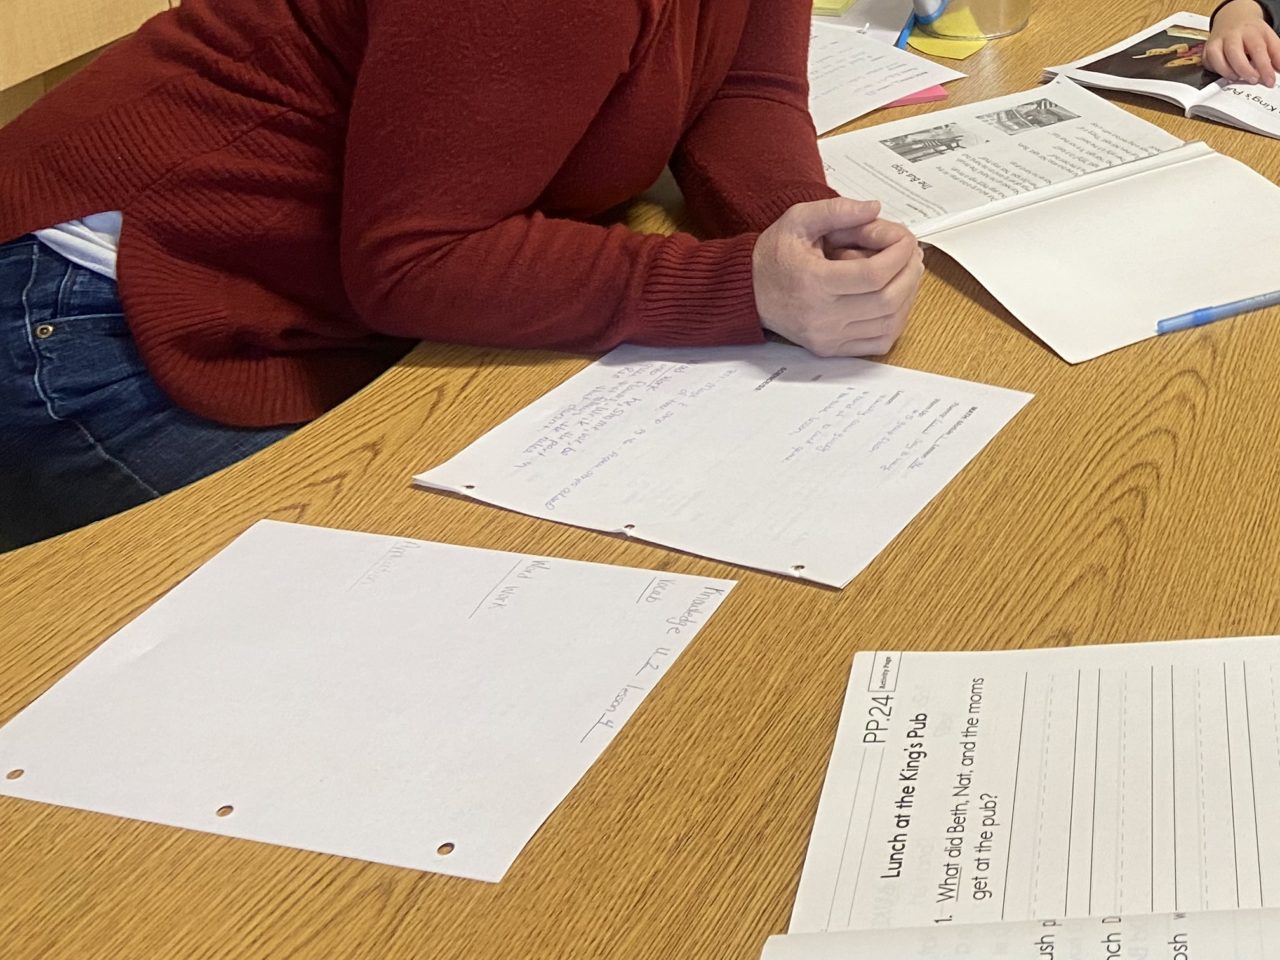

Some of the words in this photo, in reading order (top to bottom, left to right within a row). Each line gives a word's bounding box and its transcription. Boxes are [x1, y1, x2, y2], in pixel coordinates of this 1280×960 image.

[968, 677, 985, 715] moms
[862, 694, 894, 744] PP.24
[907, 712, 928, 740] Pub
[961, 716, 980, 739] the
[899, 742, 927, 783] King's
[959, 740, 977, 768] and
[952, 768, 974, 798] Nat,
[894, 785, 915, 812] the
[979, 792, 1001, 829] pub?
[894, 813, 911, 830] at
[947, 800, 970, 835] Beth,
[880, 832, 908, 879] Lunch
[944, 836, 963, 858] did
[973, 830, 994, 853] the
[974, 853, 991, 871] at
[935, 858, 961, 904] What
[972, 870, 993, 901] get
[934, 914, 953, 924] 1.
